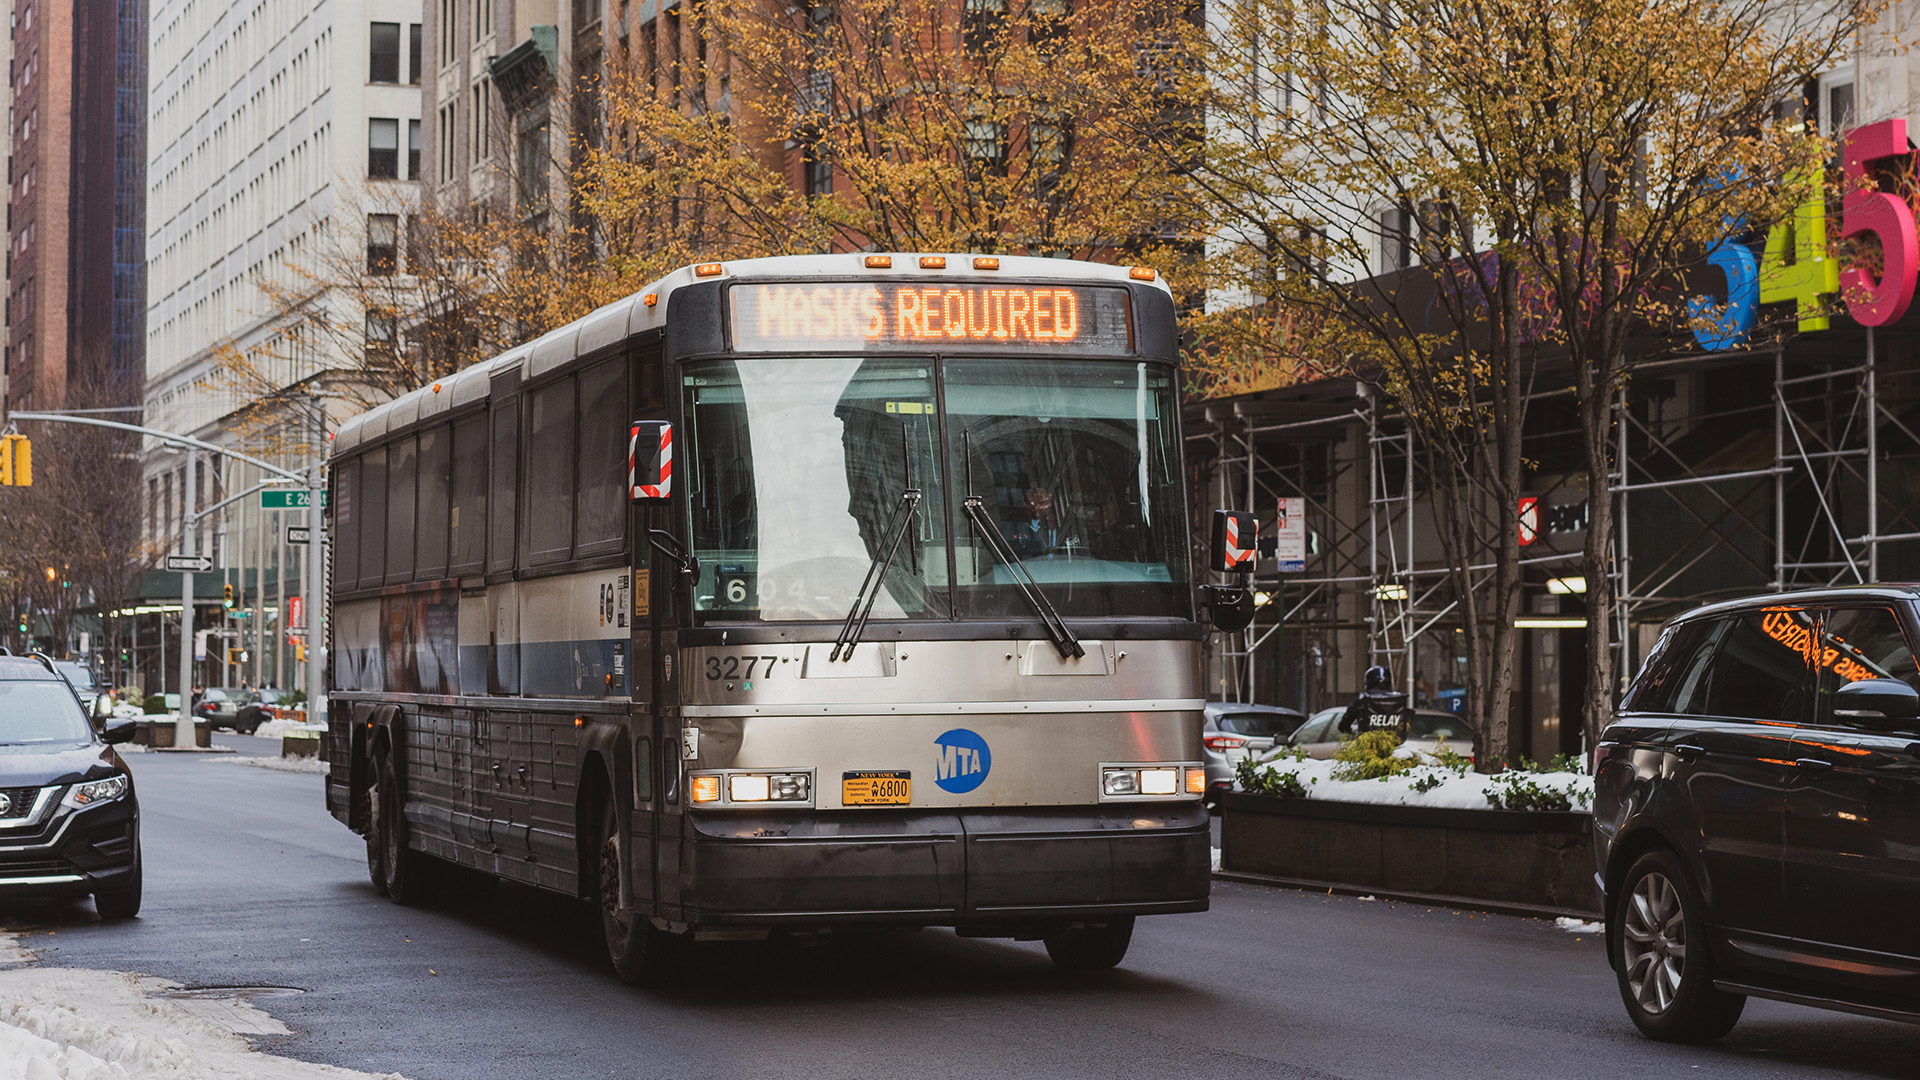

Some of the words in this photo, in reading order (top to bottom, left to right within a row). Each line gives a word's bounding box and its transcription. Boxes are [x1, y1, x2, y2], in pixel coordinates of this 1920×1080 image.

[759, 286, 884, 338] MASKS
[896, 288, 1077, 339] REQUIRED
[286, 493, 293, 506] E
[297, 493, 311, 506] 26
[706, 656, 778, 680] 3277
[1453, 699, 1461, 711] P
[1369, 714, 1400, 727] RELAY
[934, 743, 982, 781] MTA
